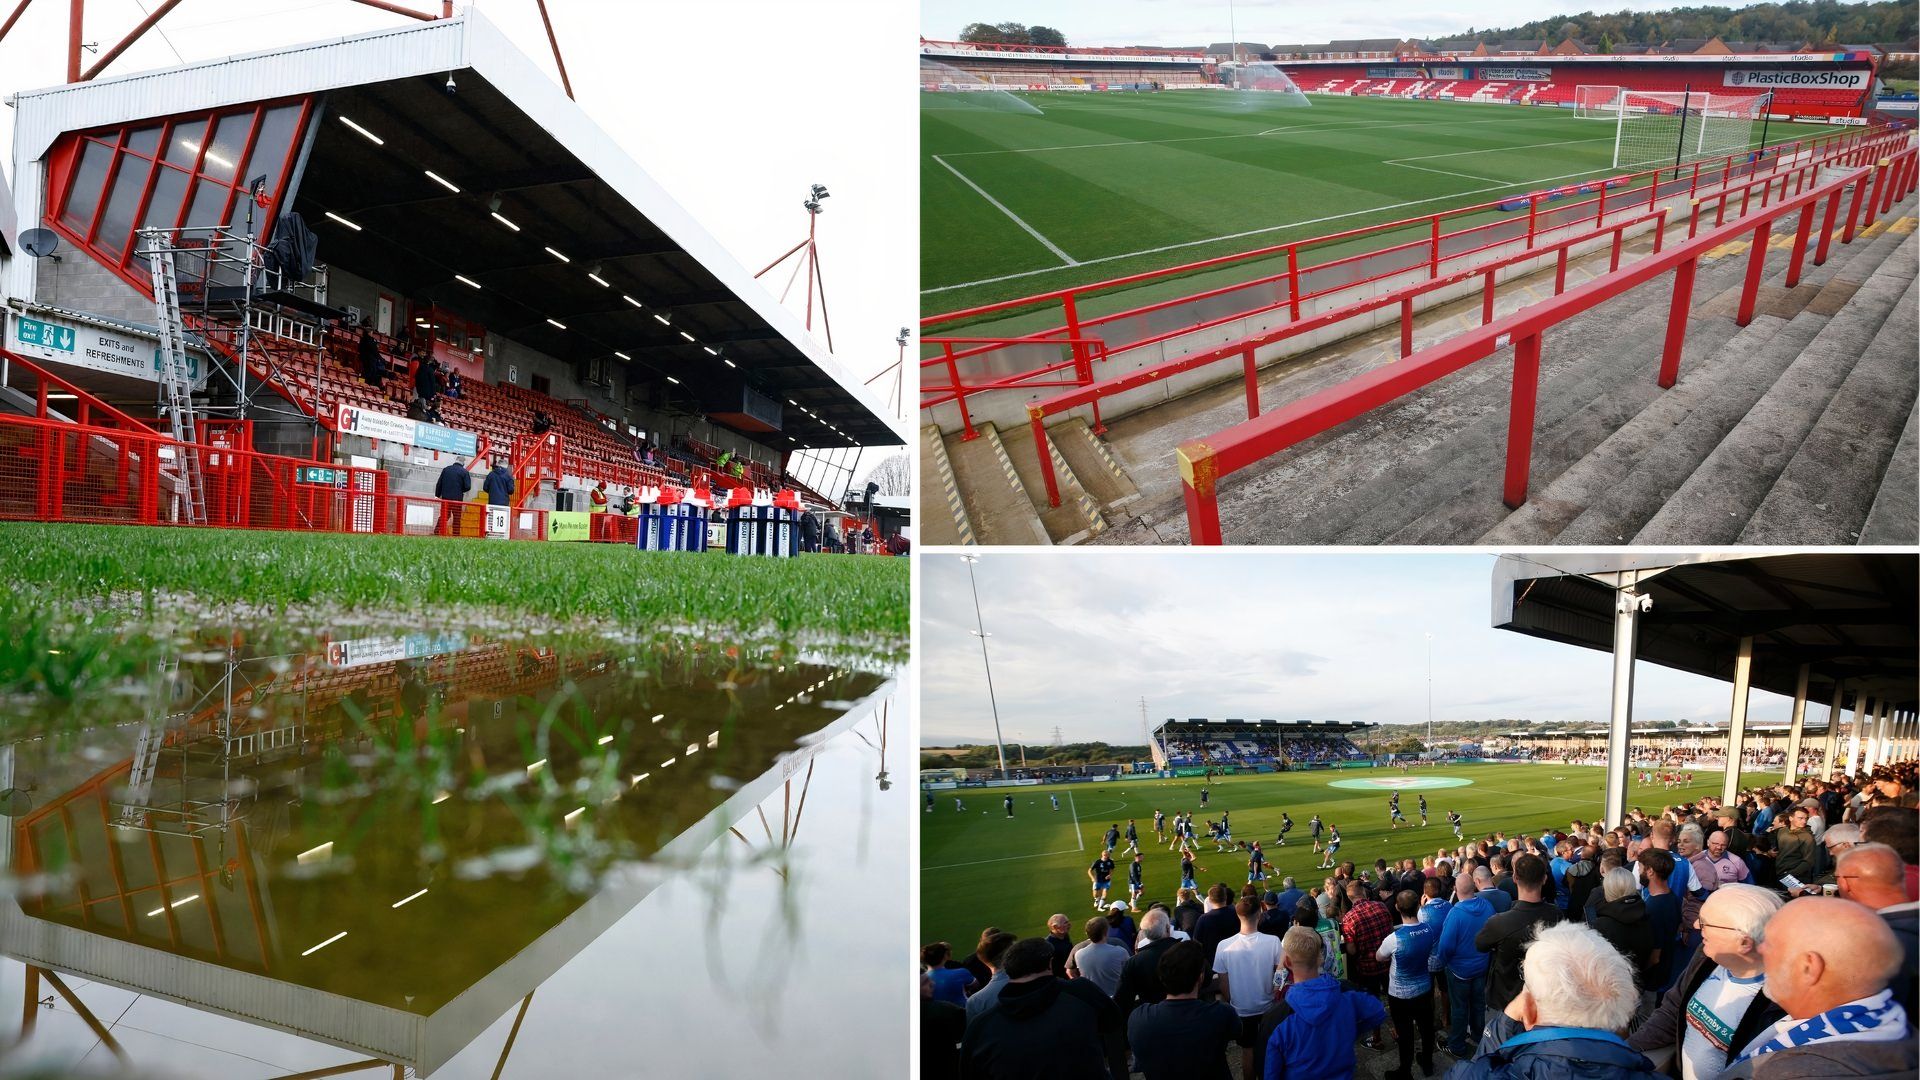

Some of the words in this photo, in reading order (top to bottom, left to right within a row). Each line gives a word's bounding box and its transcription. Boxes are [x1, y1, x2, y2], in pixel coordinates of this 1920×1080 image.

[1748, 72, 1860, 88] PlasticBoxShop
[1835, 117, 1860, 125] studio
[23, 321, 37, 331] Fire
[22, 332, 36, 341] exit
[99, 337, 120, 350] EXITS
[121, 342, 135, 354] and
[86, 348, 145, 369] REFRESHMENTS
[340, 407, 359, 432] GH
[496, 515, 504, 527] 18
[1697, 1006, 1721, 1032] Hornby
